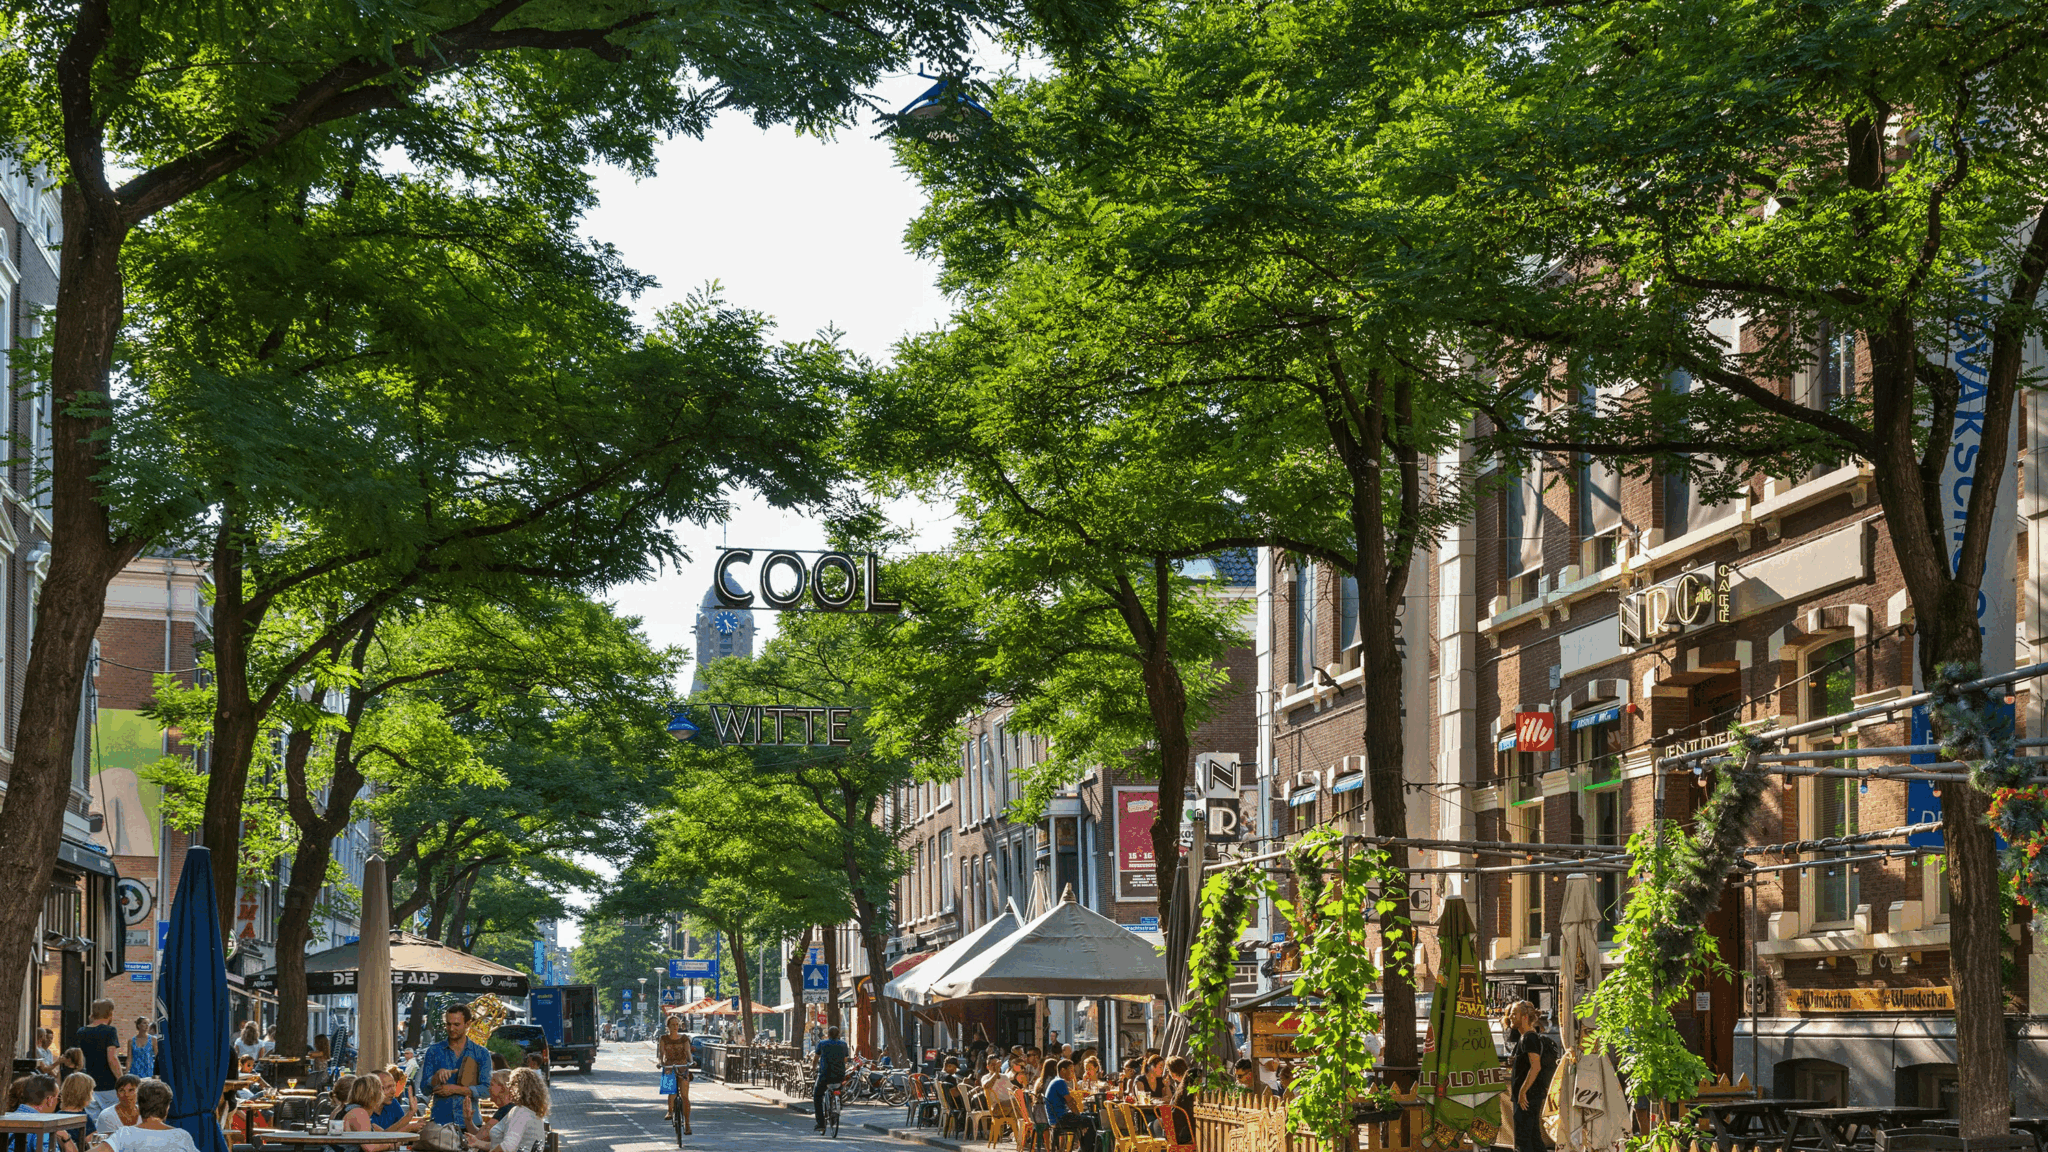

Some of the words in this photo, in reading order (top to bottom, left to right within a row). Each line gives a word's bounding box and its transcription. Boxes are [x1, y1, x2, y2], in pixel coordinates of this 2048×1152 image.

[714, 550, 901, 614] COOL
[709, 706, 852, 745] WITTE
[1518, 717, 1554, 748] illy
[333, 972, 355, 986] DE
[406, 972, 440, 985] AAP
[1797, 990, 1852, 1009] #Wunderbar
[1883, 989, 1948, 1008] #Wunderbar
